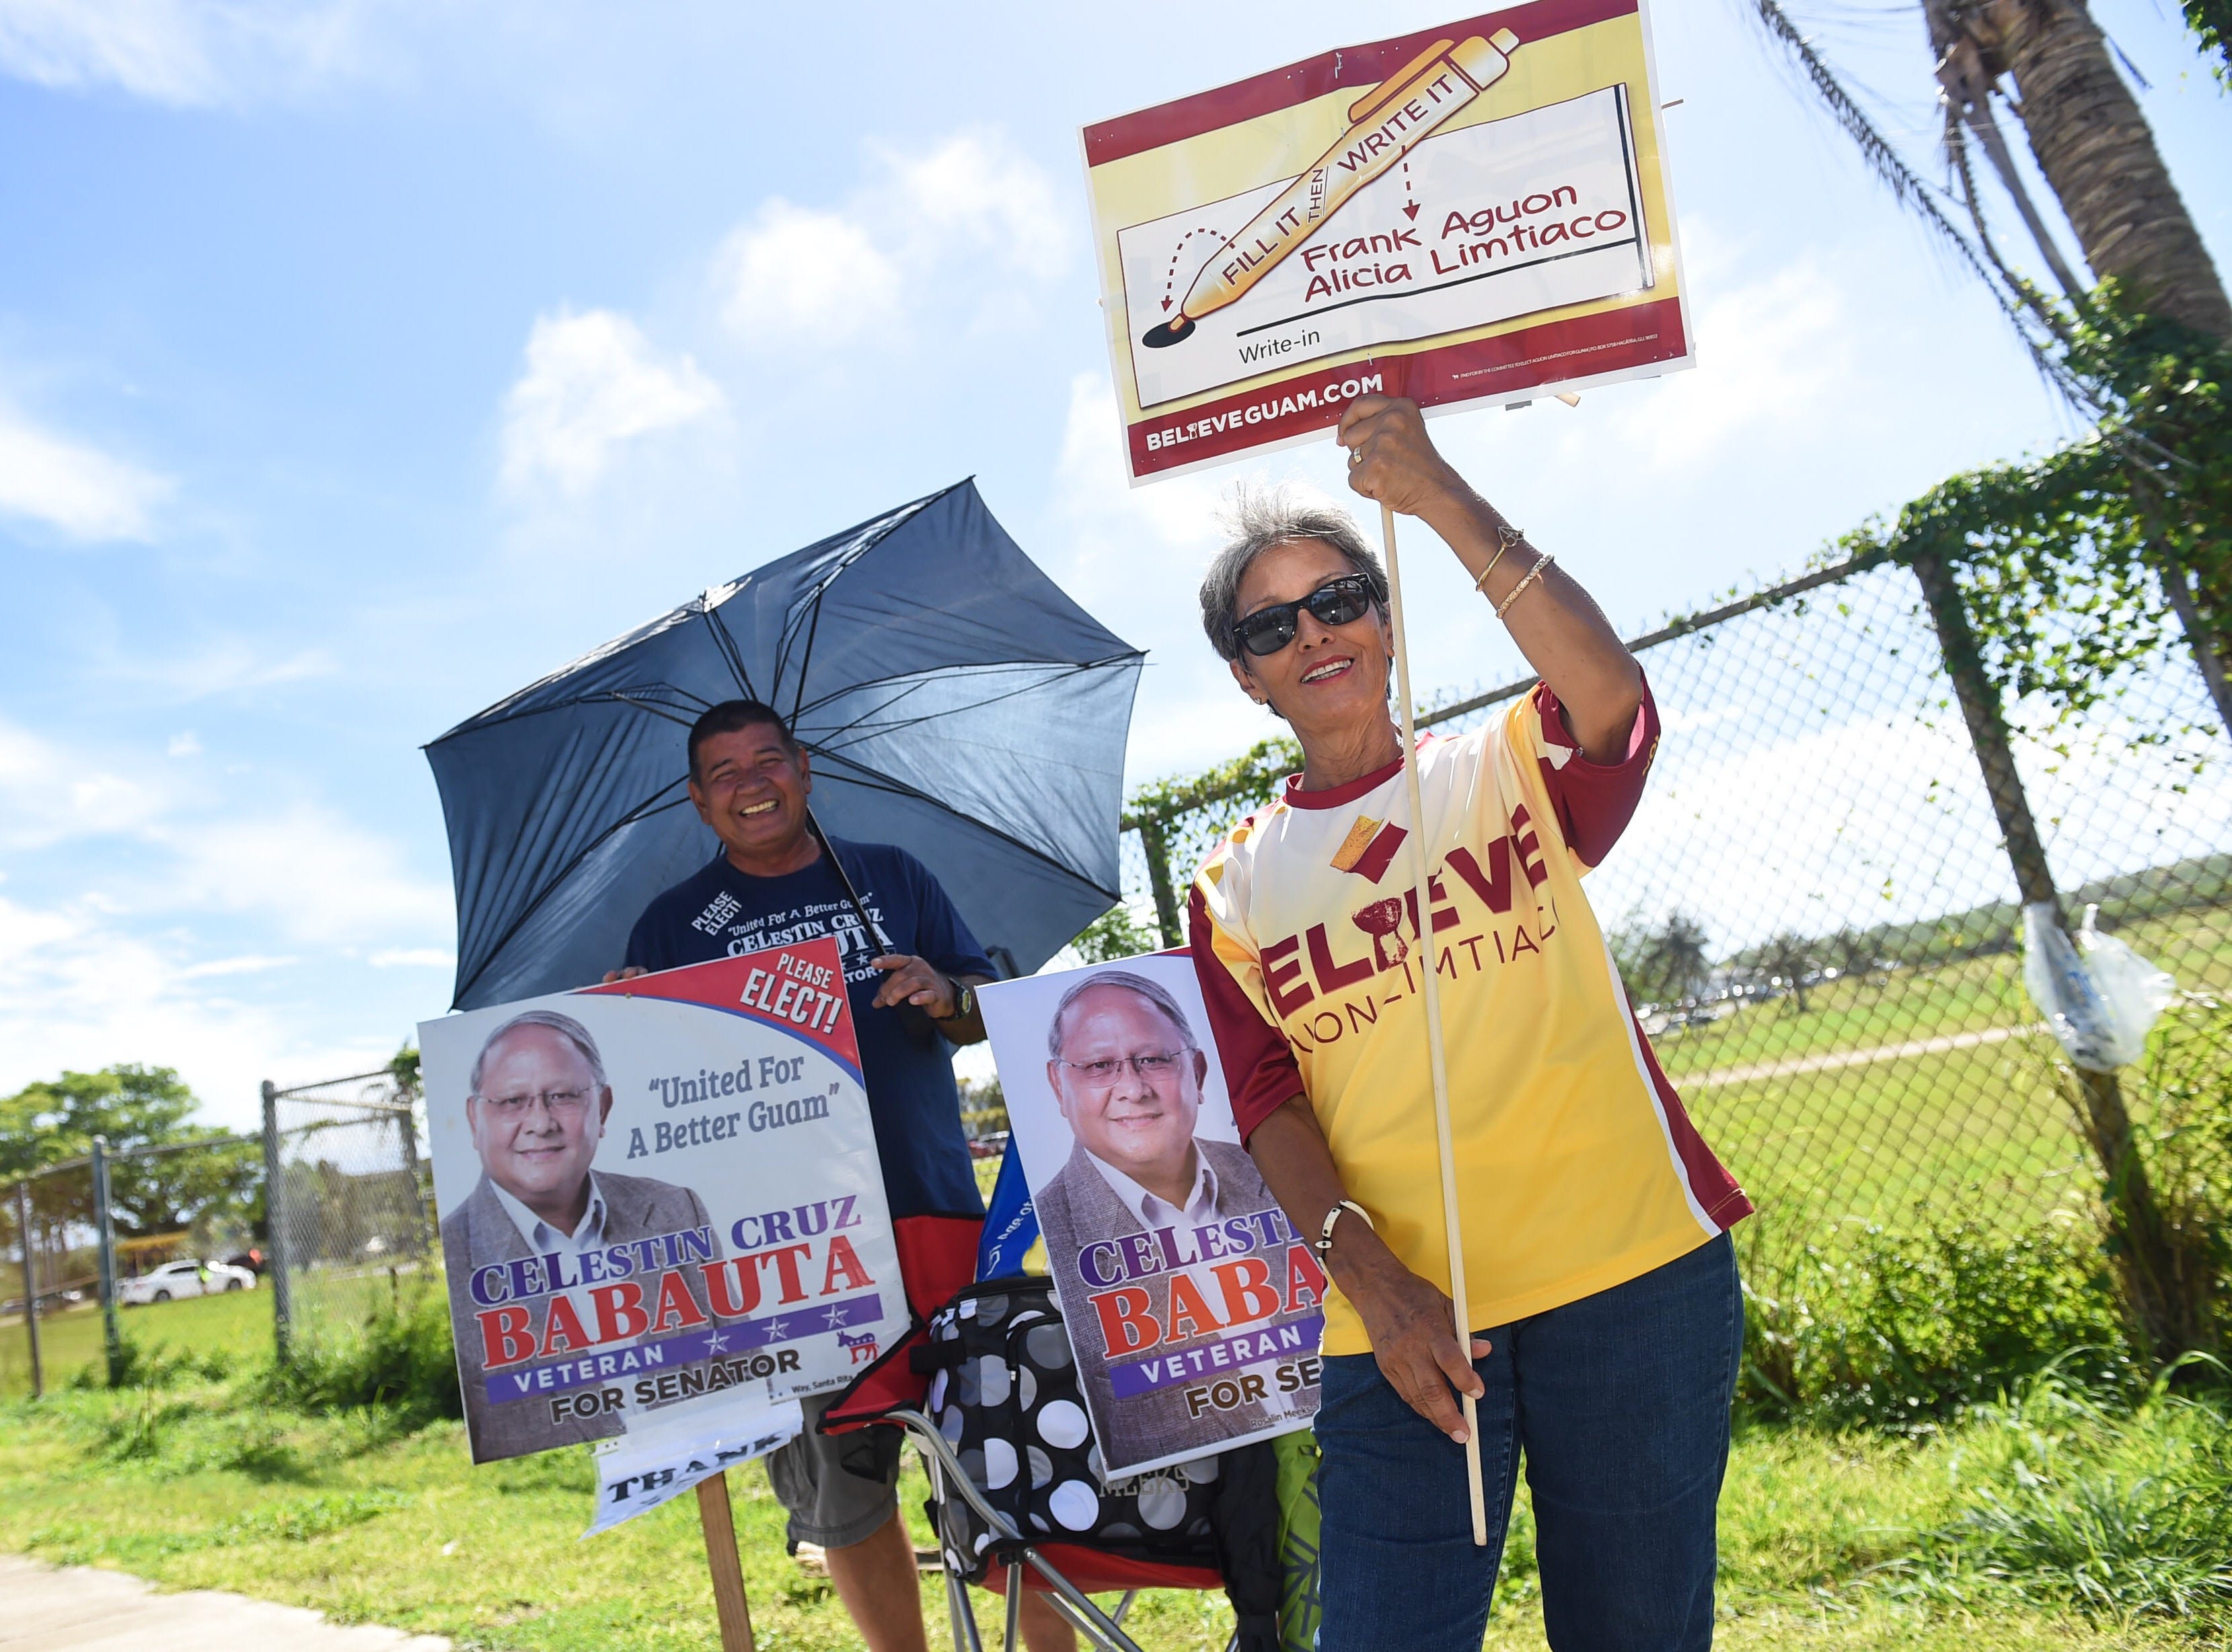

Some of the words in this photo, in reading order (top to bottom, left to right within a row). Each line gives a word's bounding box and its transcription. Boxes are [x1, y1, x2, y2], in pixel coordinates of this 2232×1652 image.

[1222, 239, 1278, 285] FILL
[1275, 206, 1301, 237] IT
[1308, 169, 1324, 223] THEN
[1337, 98, 1428, 172] WRITE
[1425, 73, 1455, 104] IT
[1300, 228, 1422, 272] Frank
[1441, 186, 1577, 239] Aguon
[1304, 262, 1413, 302] Alicia
[1430, 210, 1626, 274] Limtiaco
[1238, 329, 1320, 364] Write-in
[691, 891, 733, 931] PLEASE
[768, 911, 786, 926] For
[790, 909, 801, 919] A
[805, 903, 838, 918] Better
[727, 920, 825, 956] CELESTIN
[776, 952, 834, 989] PLEASE
[740, 968, 843, 1034] ELECT!
[758, 1056, 804, 1088] For
[627, 1127, 648, 1160] A
[655, 1111, 740, 1154] Better
[470, 1225, 712, 1306] CELESTIN
[731, 1195, 862, 1250] CRUZ
[1078, 1208, 1304, 1288] CELESTI
[476, 1234, 875, 1370] BABAUTA
[1088, 1245, 1325, 1359] BABA
[514, 1345, 663, 1394] VETERAN
[1140, 1325, 1302, 1384] VETERAN
[550, 1396, 626, 1425] FOR
[634, 1349, 802, 1404] SENATOR
[812, 1379, 835, 1389] Santa
[1185, 1374, 1269, 1419] FOR
[1251, 1414, 1282, 1428] Rosalin
[1284, 1406, 1310, 1419] Meeks
